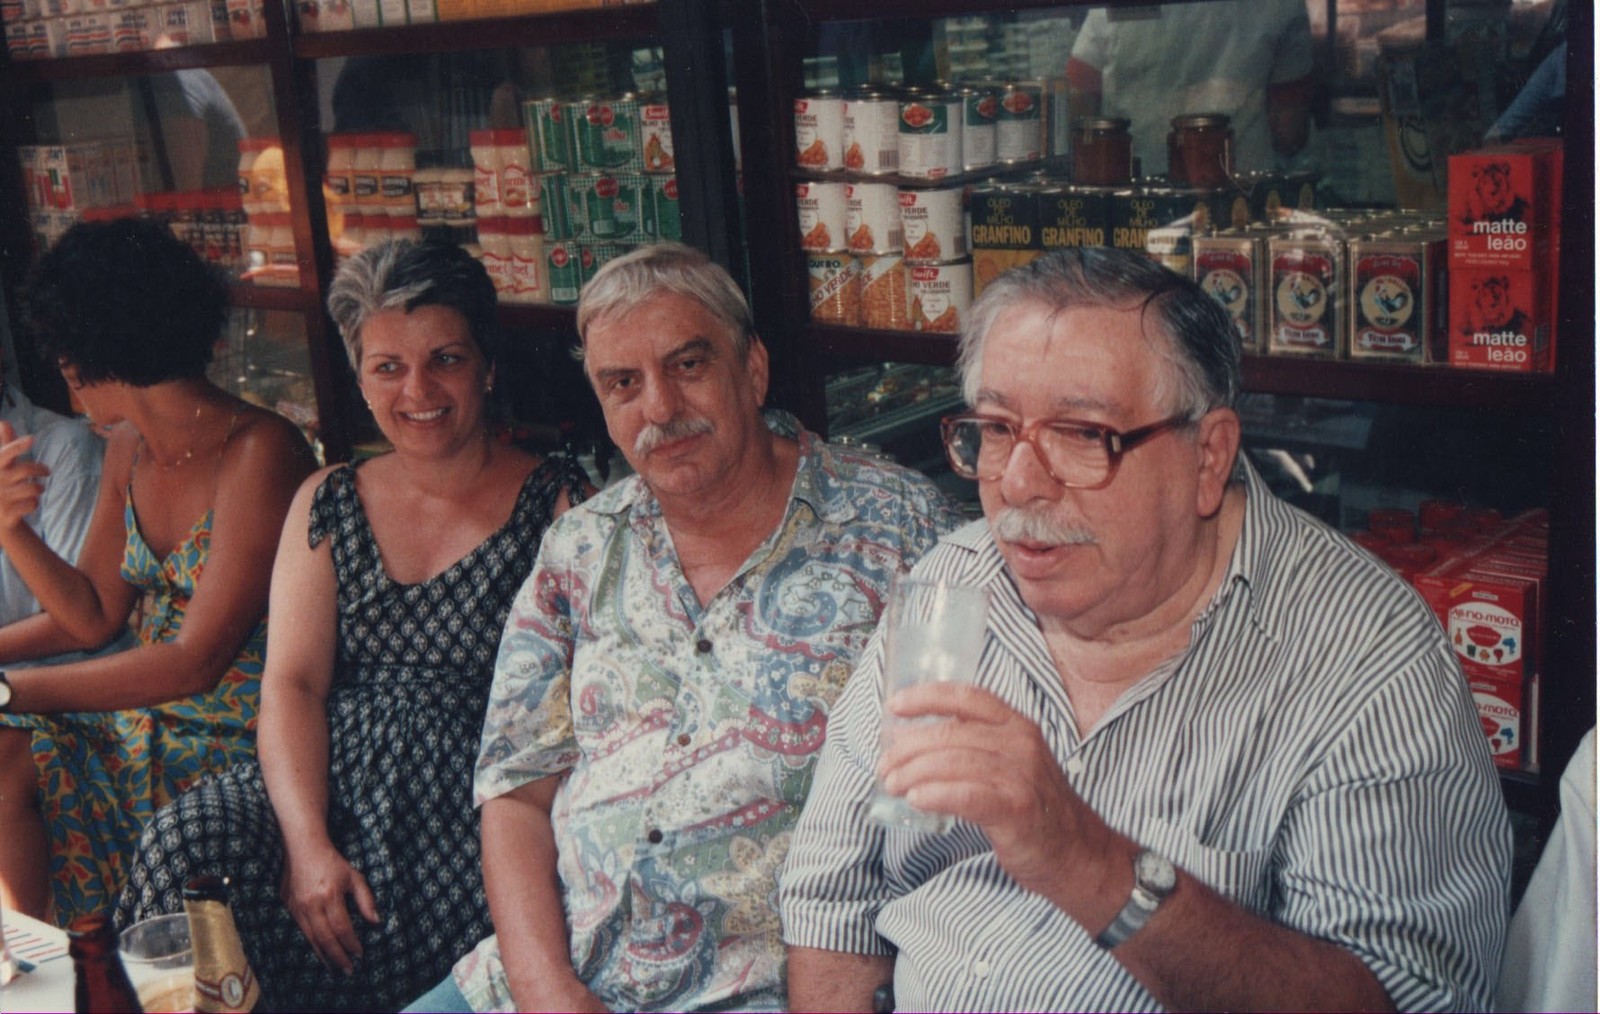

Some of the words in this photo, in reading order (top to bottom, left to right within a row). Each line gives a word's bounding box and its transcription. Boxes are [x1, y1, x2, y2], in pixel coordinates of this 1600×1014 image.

[1473, 218, 1527, 234] matte
[973, 225, 1031, 245] GRANFINO
[1042, 227, 1104, 247] GRANFINO
[1487, 235, 1527, 251] leão
[823, 266, 854, 295] VERDE
[922, 281, 951, 289] VERDE
[1473, 331, 1527, 346] matte
[1487, 346, 1527, 362] leão
